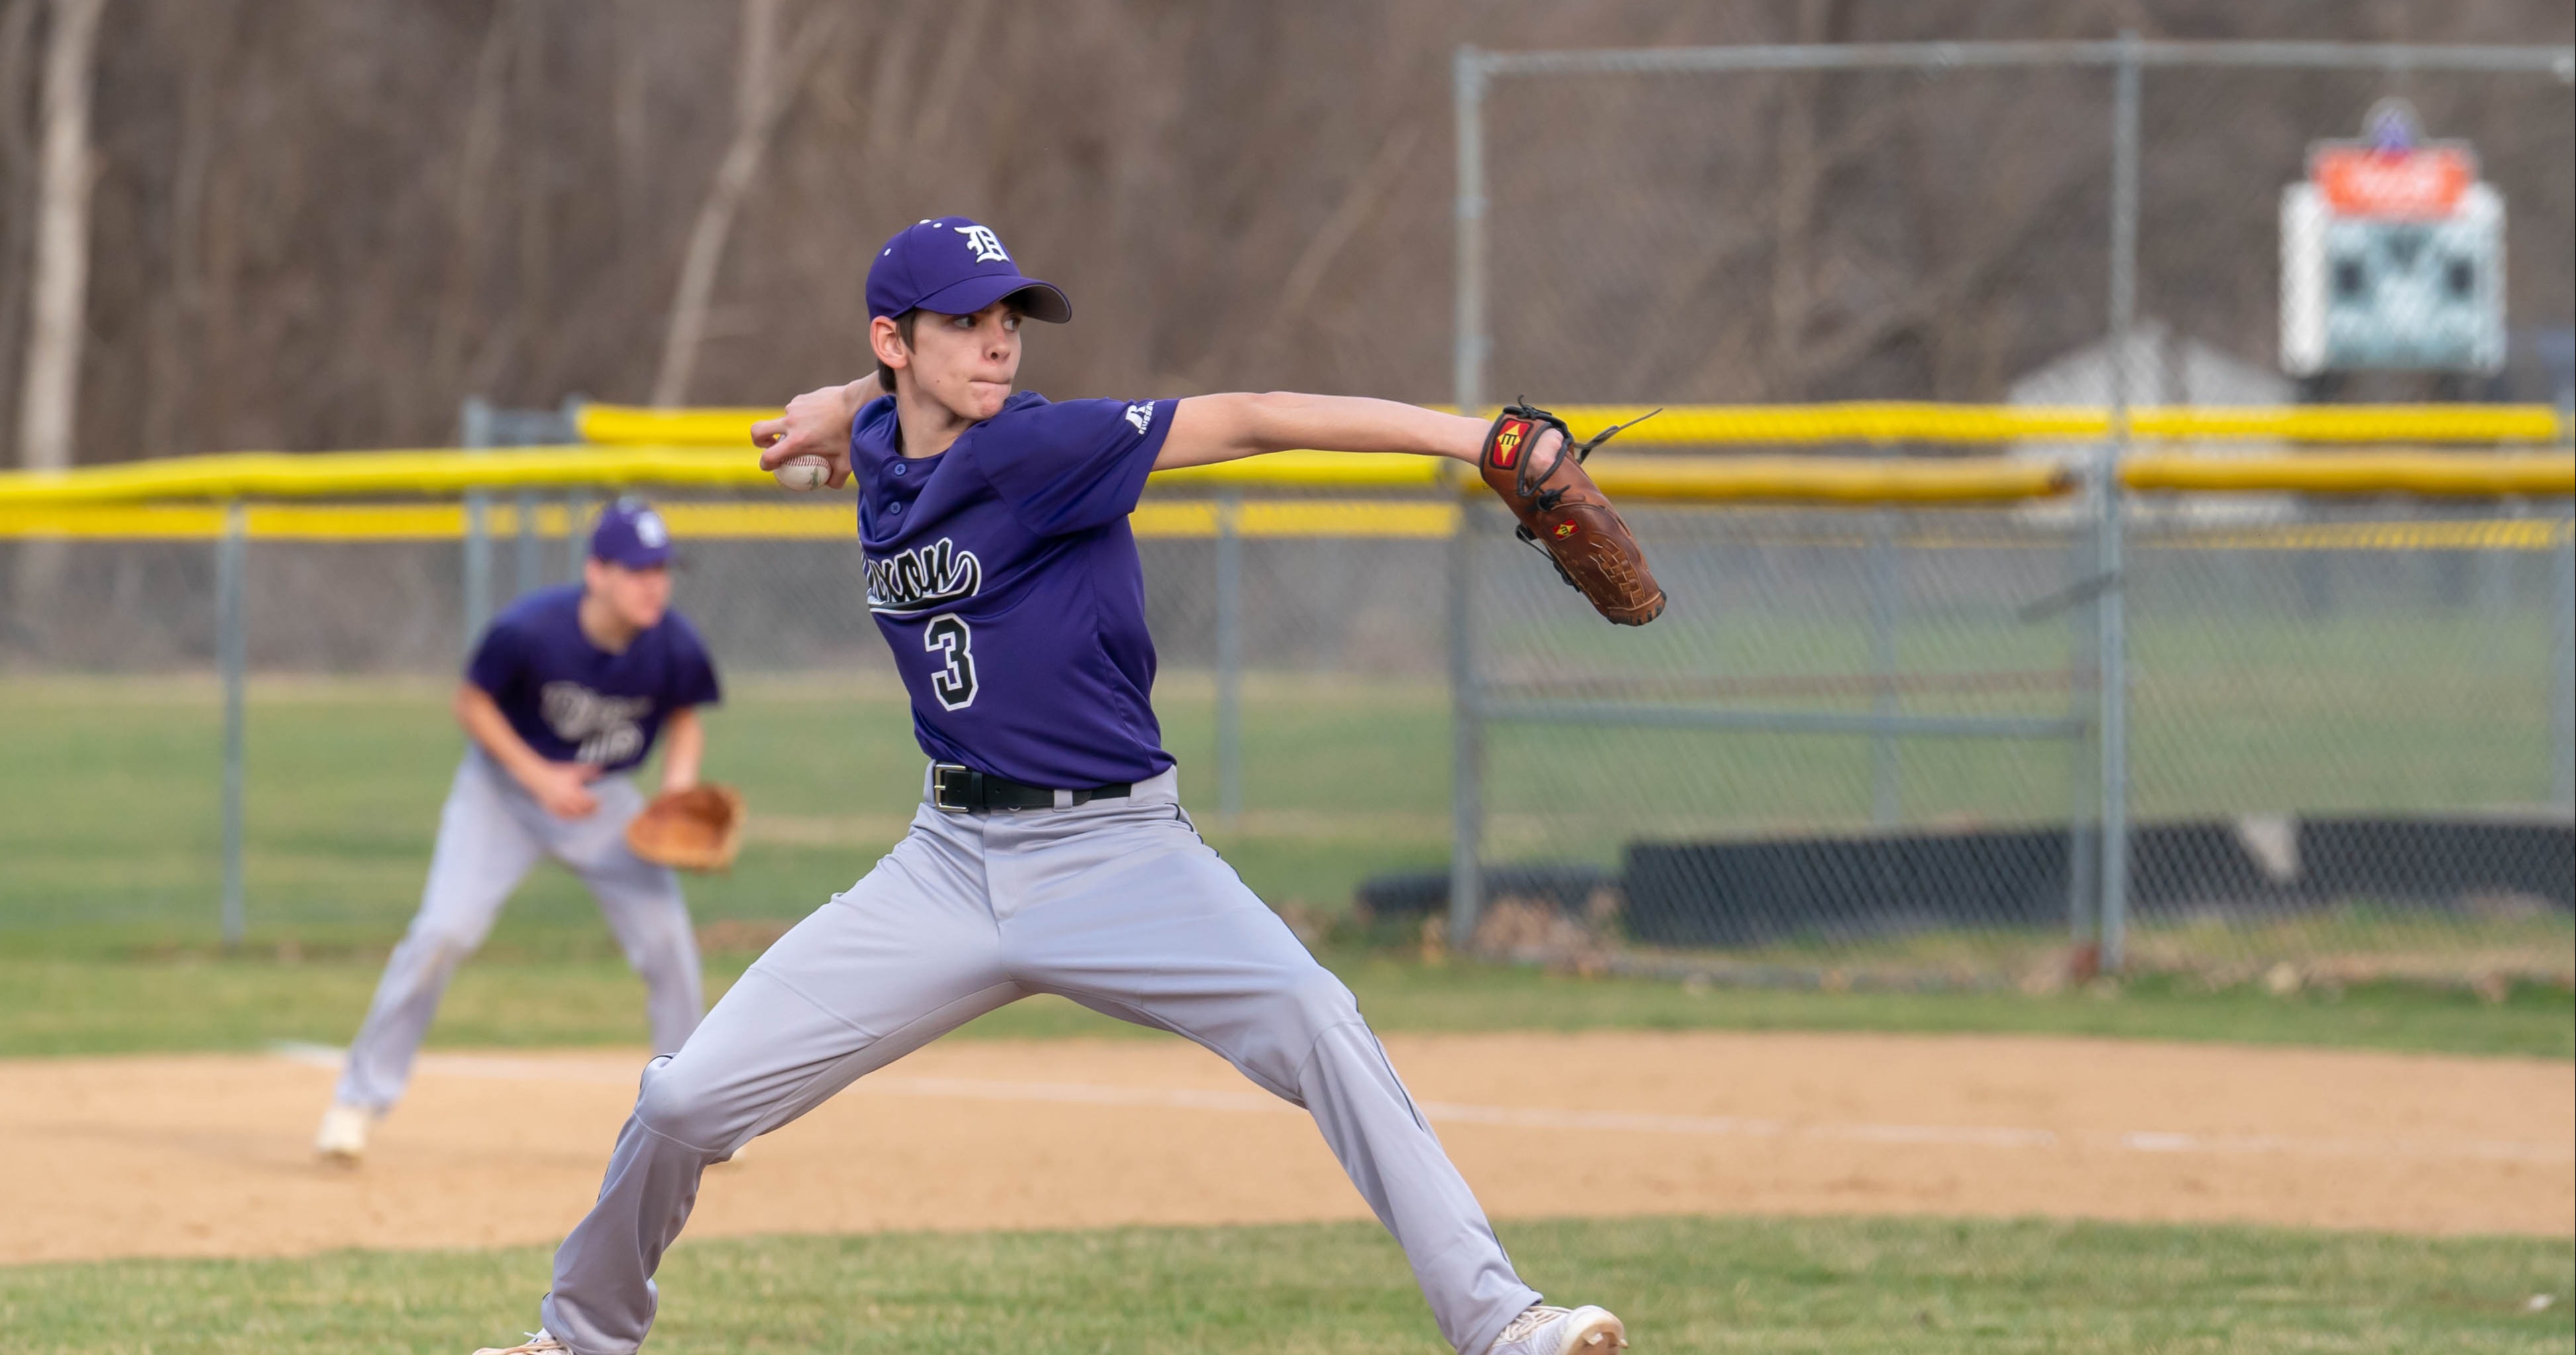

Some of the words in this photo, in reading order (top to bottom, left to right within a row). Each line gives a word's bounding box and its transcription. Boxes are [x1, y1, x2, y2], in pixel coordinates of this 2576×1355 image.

[954, 225, 1011, 264] D
[864, 537, 981, 610] xon
[924, 612, 979, 711] 3
